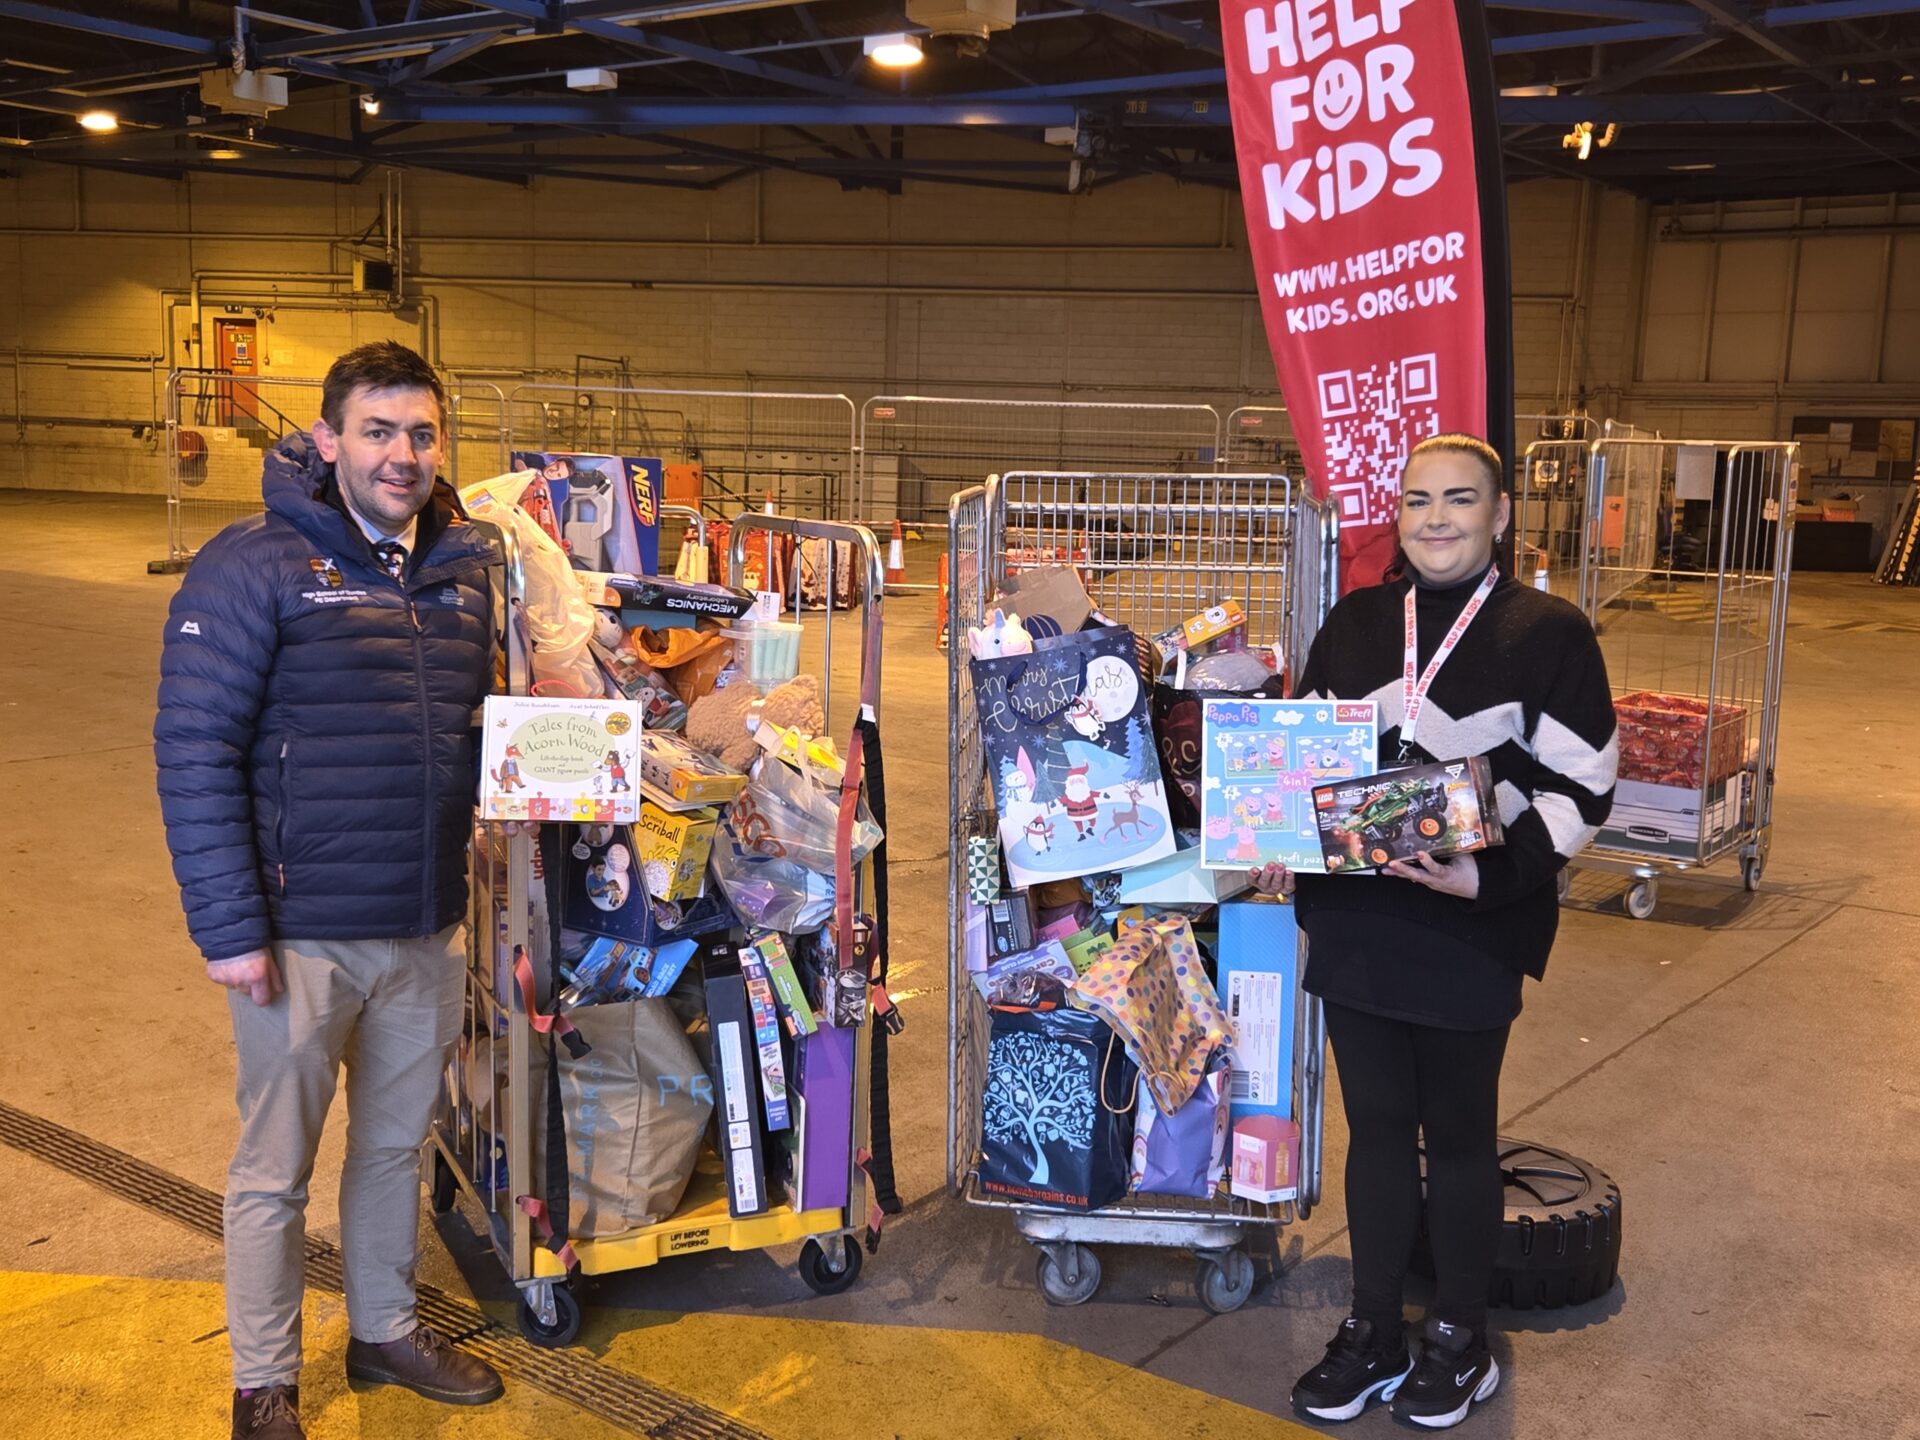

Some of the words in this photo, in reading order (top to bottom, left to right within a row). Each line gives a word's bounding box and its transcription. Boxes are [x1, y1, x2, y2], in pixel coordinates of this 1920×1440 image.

[1271, 44, 1415, 151] FOR
[1273, 232, 1465, 297] WWW.HELPFOR
[1286, 274, 1458, 334] KIDS.ORG.UK
[631, 464, 656, 526] NERF
[666, 598, 739, 615] MECHANICS
[686, 592, 729, 605] Laboratory
[1444, 631, 1458, 649] HELP
[1208, 705, 1241, 724] Peppa
[1241, 704, 1259, 724] Pig
[1349, 708, 1371, 718] Trefl
[1409, 699, 1420, 720] HELP
[529, 718, 562, 736] Tales
[566, 717, 598, 738] from
[524, 738, 565, 755] Acorn
[569, 734, 606, 757] Wood
[1316, 793, 1333, 803] LEGO
[1337, 781, 1392, 799] TECHNIC
[638, 814, 682, 844] Scriball
[1278, 853, 1300, 863] trefl
[671, 1233, 683, 1241] LIFT
[683, 1229, 710, 1238] BEFORE
[671, 1238, 709, 1250] LOWERING
